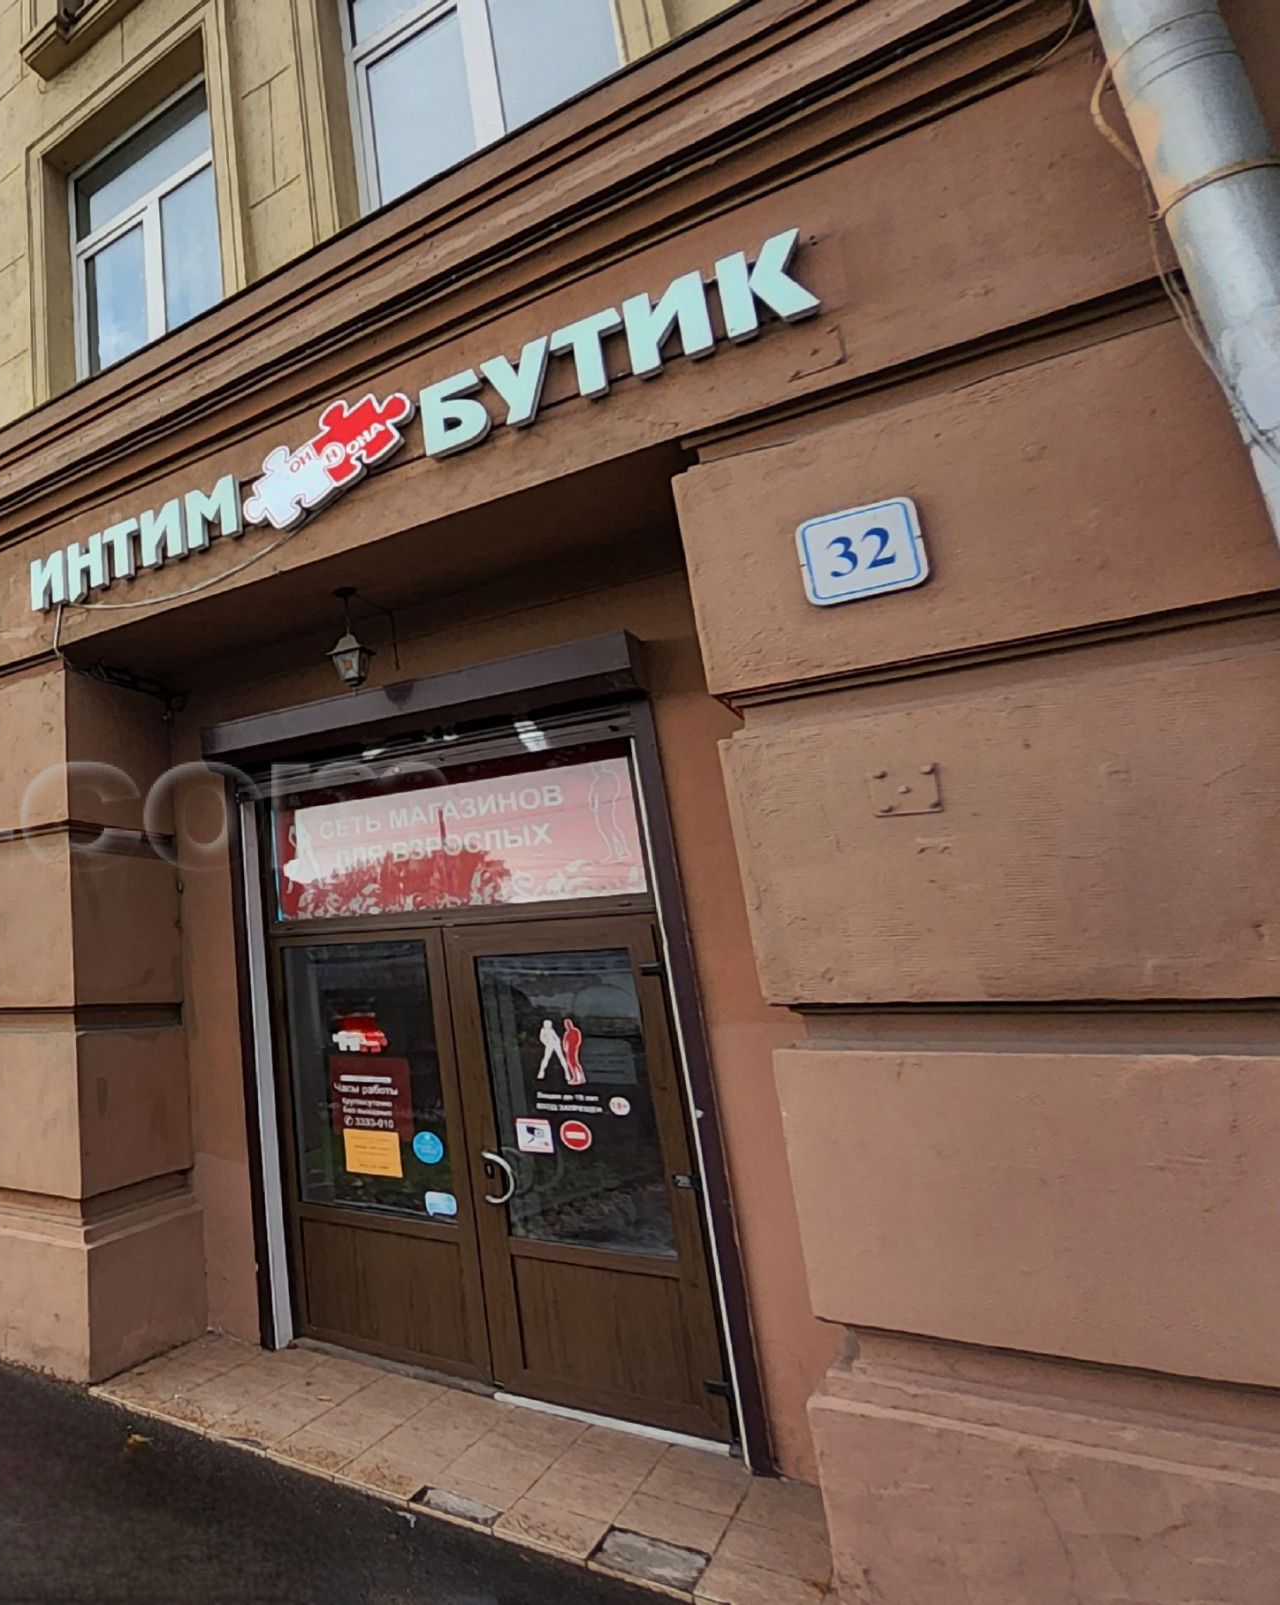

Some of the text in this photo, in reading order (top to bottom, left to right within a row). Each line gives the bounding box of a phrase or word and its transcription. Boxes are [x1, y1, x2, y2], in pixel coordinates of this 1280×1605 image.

[29, 228, 822, 612] ИНТИМ БУТИК
[289, 451, 312, 473] ОН
[345, 422, 385, 455] ОНА
[826, 527, 897, 578] 32
[318, 784, 565, 841] СЕТЬ МАГАЗИНОВ
[333, 822, 554, 874] ДЛЯ ВЗРОСЛЫХ
